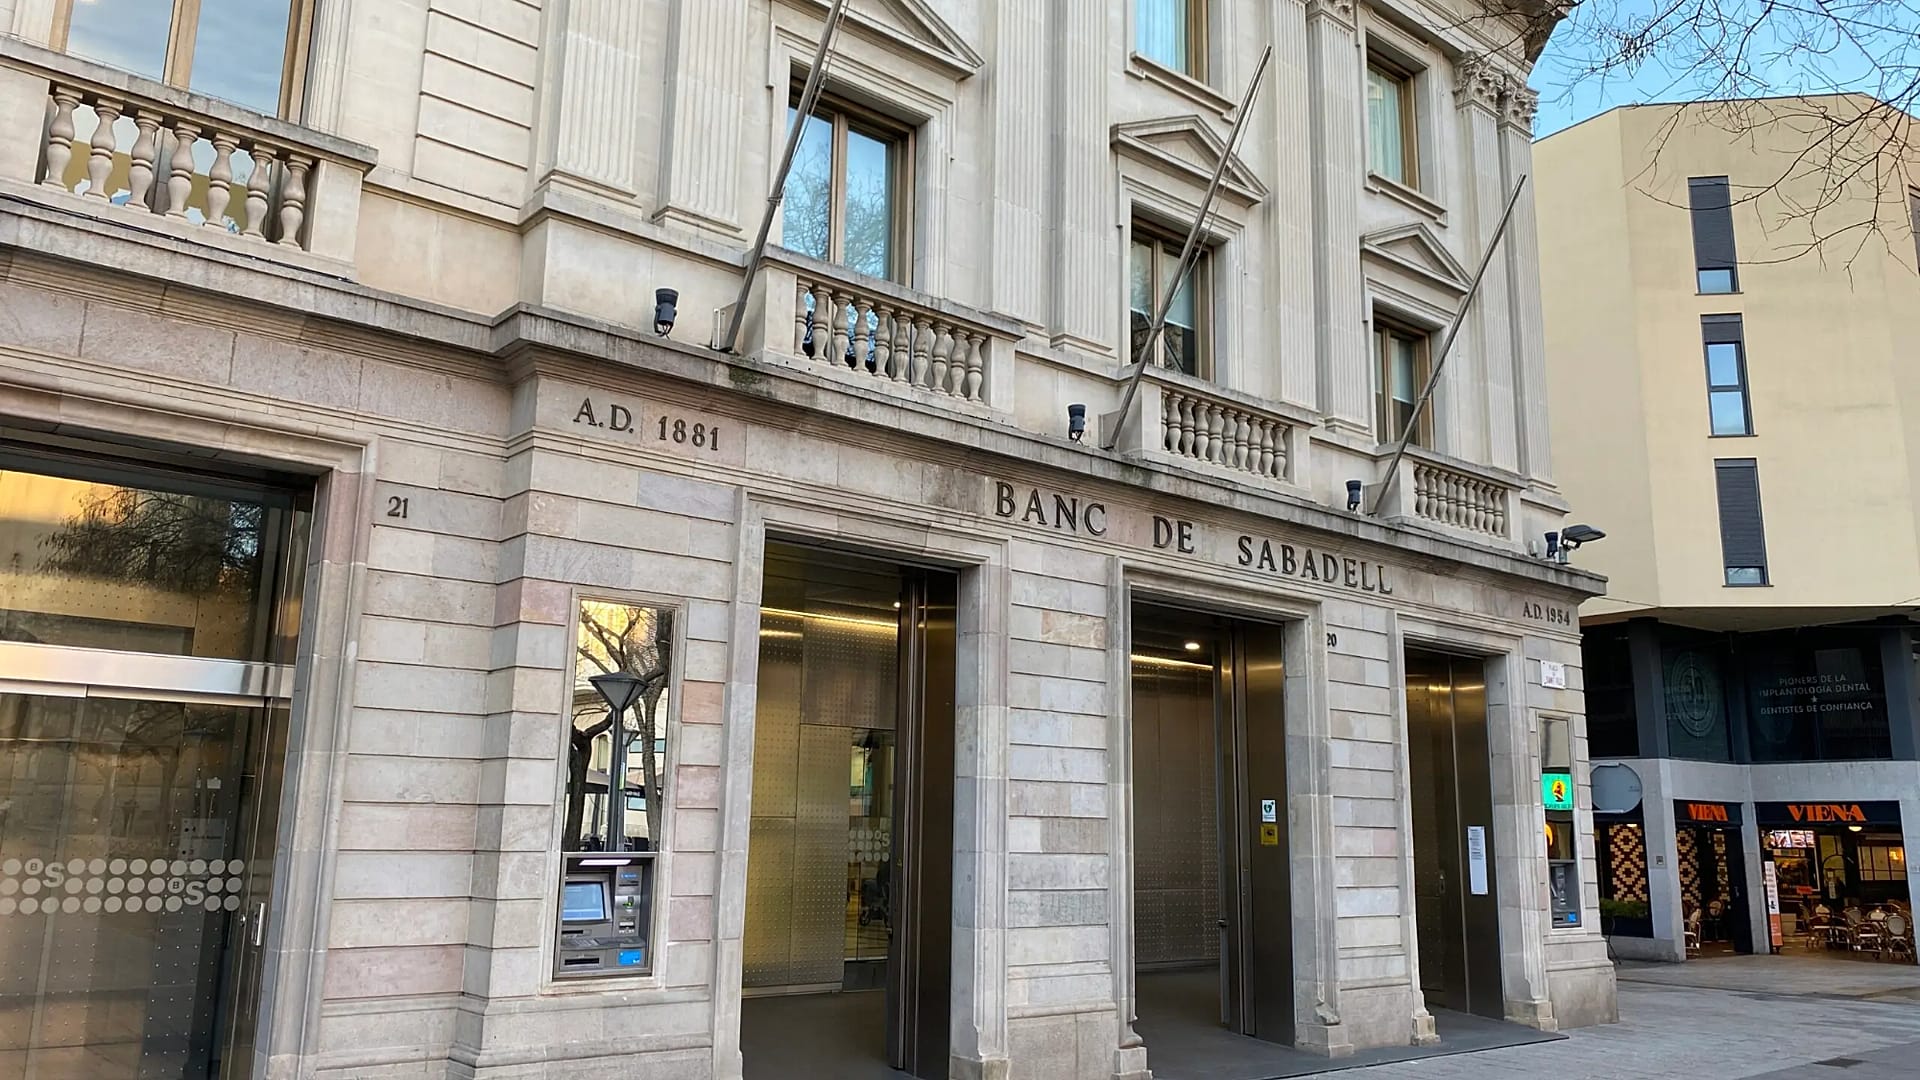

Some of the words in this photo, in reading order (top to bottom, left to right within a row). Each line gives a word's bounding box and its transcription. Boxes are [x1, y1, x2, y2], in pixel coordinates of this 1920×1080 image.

[573, 397, 635, 434] A.D.
[658, 415, 720, 451] 1881
[387, 495, 409, 519] 21
[996, 481, 1107, 537] BANC
[1153, 515, 1195, 554] DE
[1238, 534, 1393, 595] SABADELL
[1523, 601, 1543, 620] A.D.
[1546, 605, 1571, 626] 1954
[1326, 632, 1337, 647] 20
[1779, 675, 1818, 686] PIONERS
[1820, 675, 1832, 683] DE
[1835, 673, 1846, 682] LA
[1835, 682, 1872, 693] DENTAL
[1760, 705, 1804, 715] DENTISTES
[1806, 704, 1818, 713] DE
[1820, 701, 1873, 712] CONFIANÇA
[1687, 803, 1728, 822] VIENA
[1787, 804, 1867, 822] VIENA
